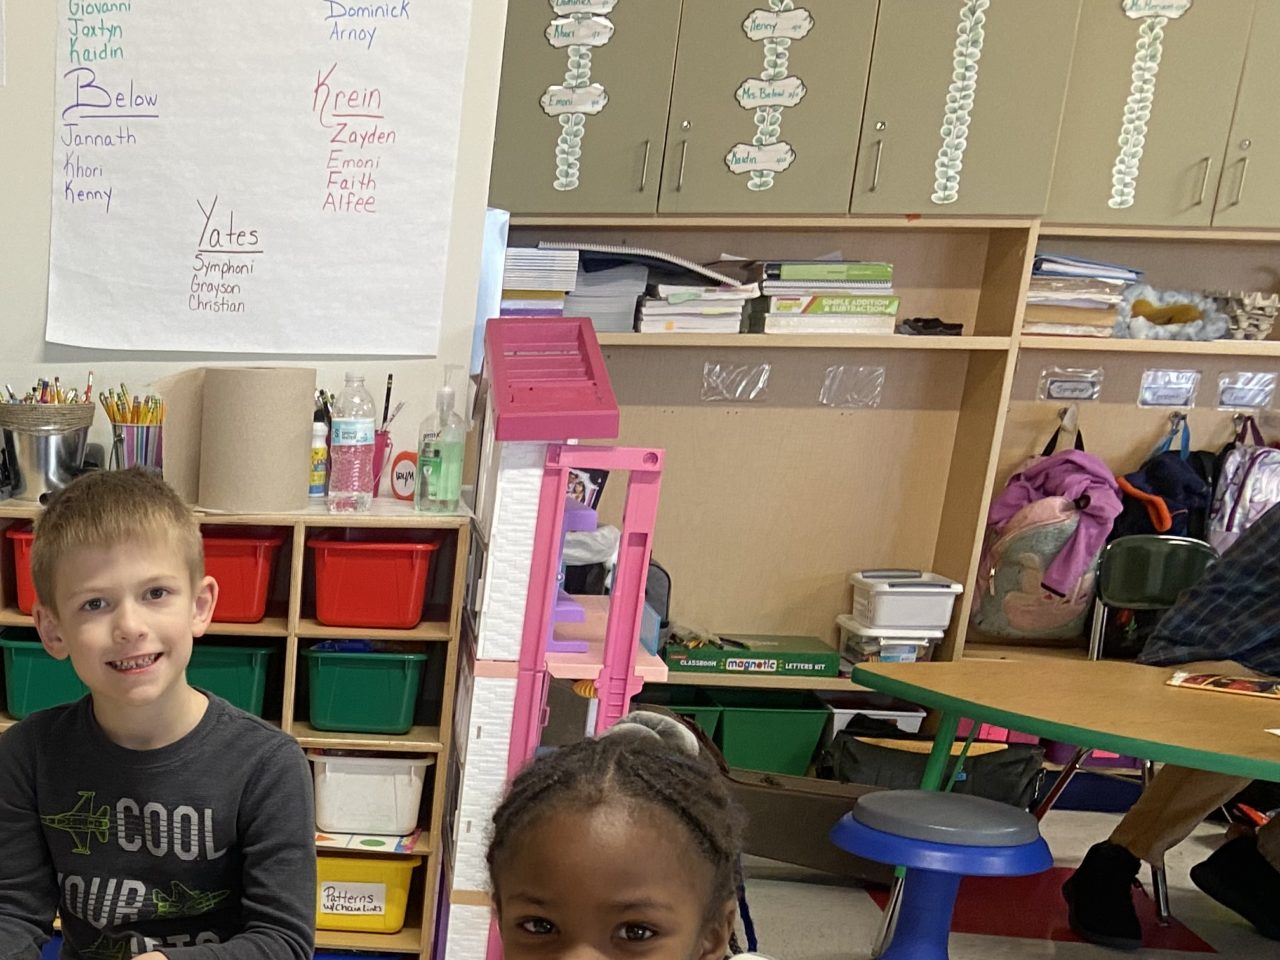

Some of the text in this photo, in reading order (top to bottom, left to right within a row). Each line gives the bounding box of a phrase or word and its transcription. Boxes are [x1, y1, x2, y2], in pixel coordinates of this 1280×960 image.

[325, 0, 410, 21] Dominick
[69, 38, 124, 63] Kaidin
[62, 67, 158, 120] Below
[313, 62, 383, 128] Krein
[61, 123, 136, 147] Jannath
[330, 123, 396, 150] Zayden
[63, 152, 103, 179] Khori
[327, 149, 381, 170] Emoni
[327, 172, 377, 191] Faith
[64, 181, 112, 214] Kenny
[322, 192, 377, 214] Alfee
[197, 195, 259, 249] Yates
[192, 253, 254, 277] Symphoni
[190, 275, 241, 297] Grayson
[188, 294, 245, 313] Christian
[680, 660, 717, 668] CLASSROOM
[726, 658, 777, 671] magnetic
[116, 797, 228, 861] COOL
[57, 872, 146, 929] OUR
[323, 886, 374, 904] Patterns
